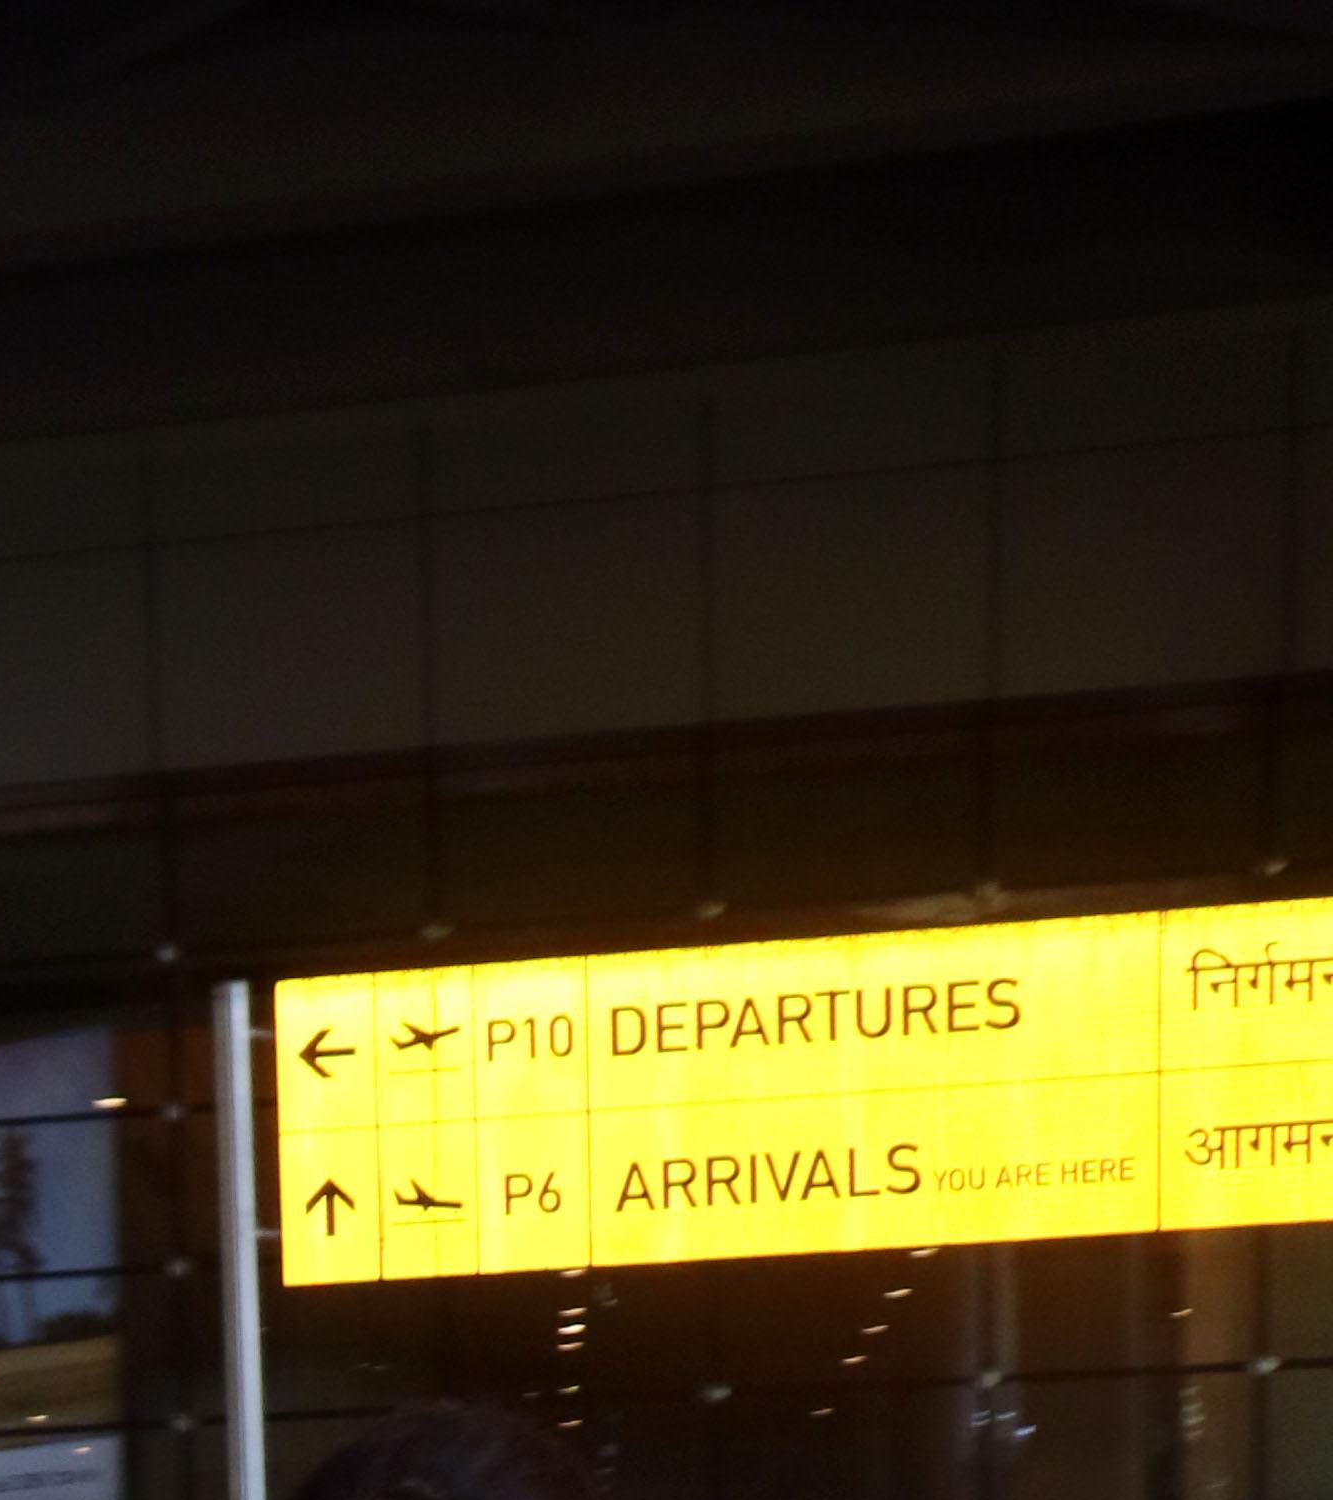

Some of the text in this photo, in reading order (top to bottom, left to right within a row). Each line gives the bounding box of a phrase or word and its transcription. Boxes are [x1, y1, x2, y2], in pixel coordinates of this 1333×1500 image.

[486, 977, 1024, 1062] P10 DEPARTURES
[503, 1142, 1137, 1217] P6 ARRIVALS YOU ARE HERE
